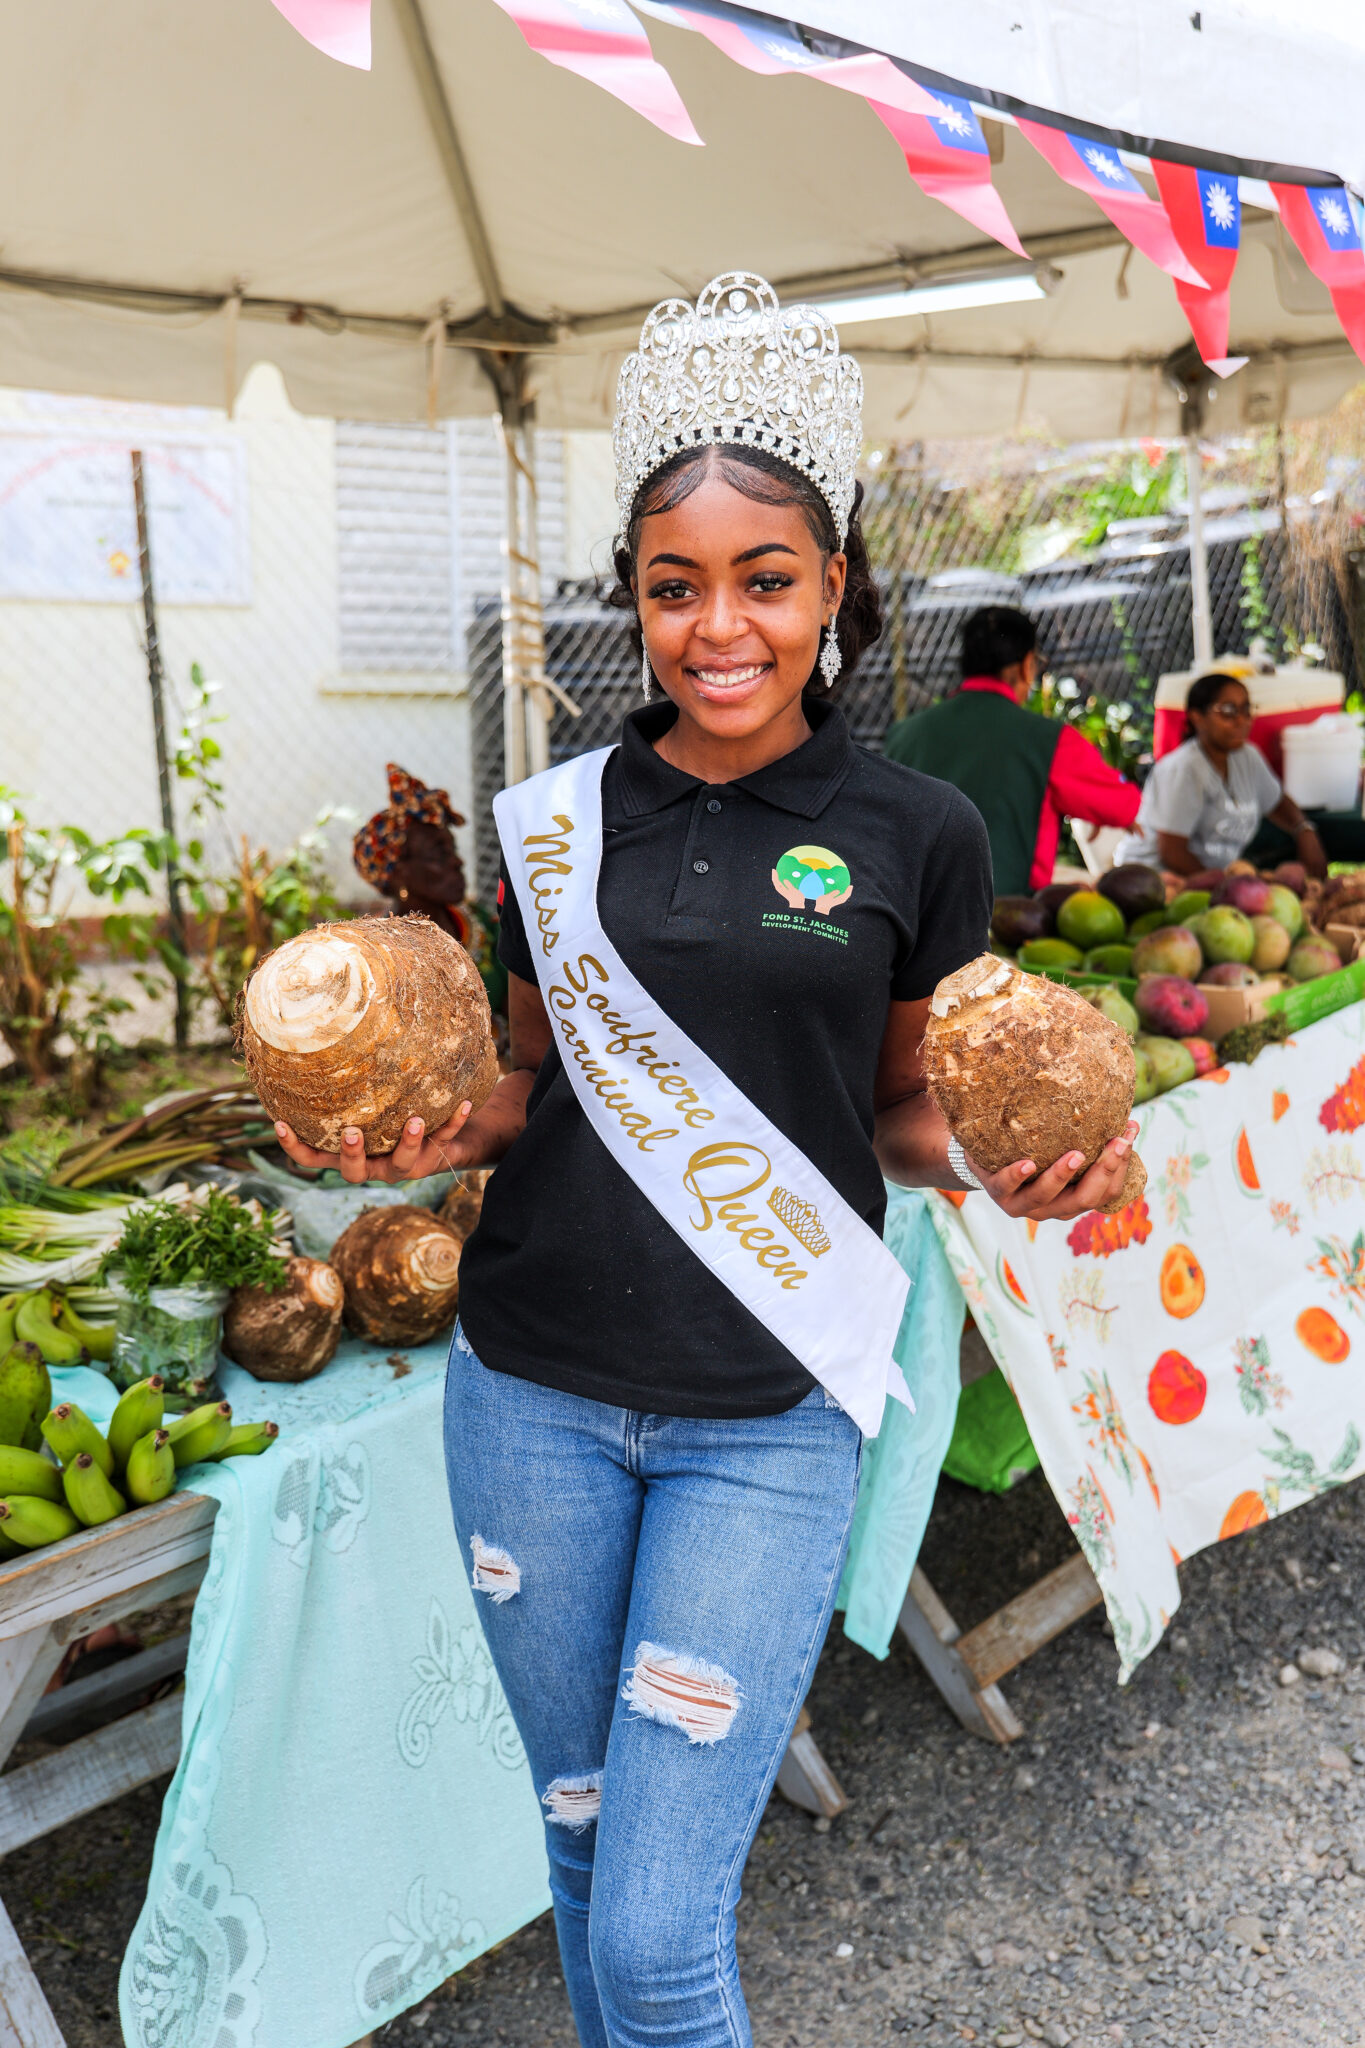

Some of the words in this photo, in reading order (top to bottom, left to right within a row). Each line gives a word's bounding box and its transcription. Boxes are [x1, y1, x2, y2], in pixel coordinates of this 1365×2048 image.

[523, 814, 575, 957] Miss
[563, 953, 715, 1129] Soufriere
[761, 921, 811, 933] DEVELOPMENT
[812, 929, 849, 946] COMMITTEE
[762, 913, 791, 922] FOND
[793, 916, 807, 925] ST.
[809, 920, 849, 938] JACQUES
[549, 985, 680, 1152] Carnival
[683, 1141, 808, 1290] Queen
